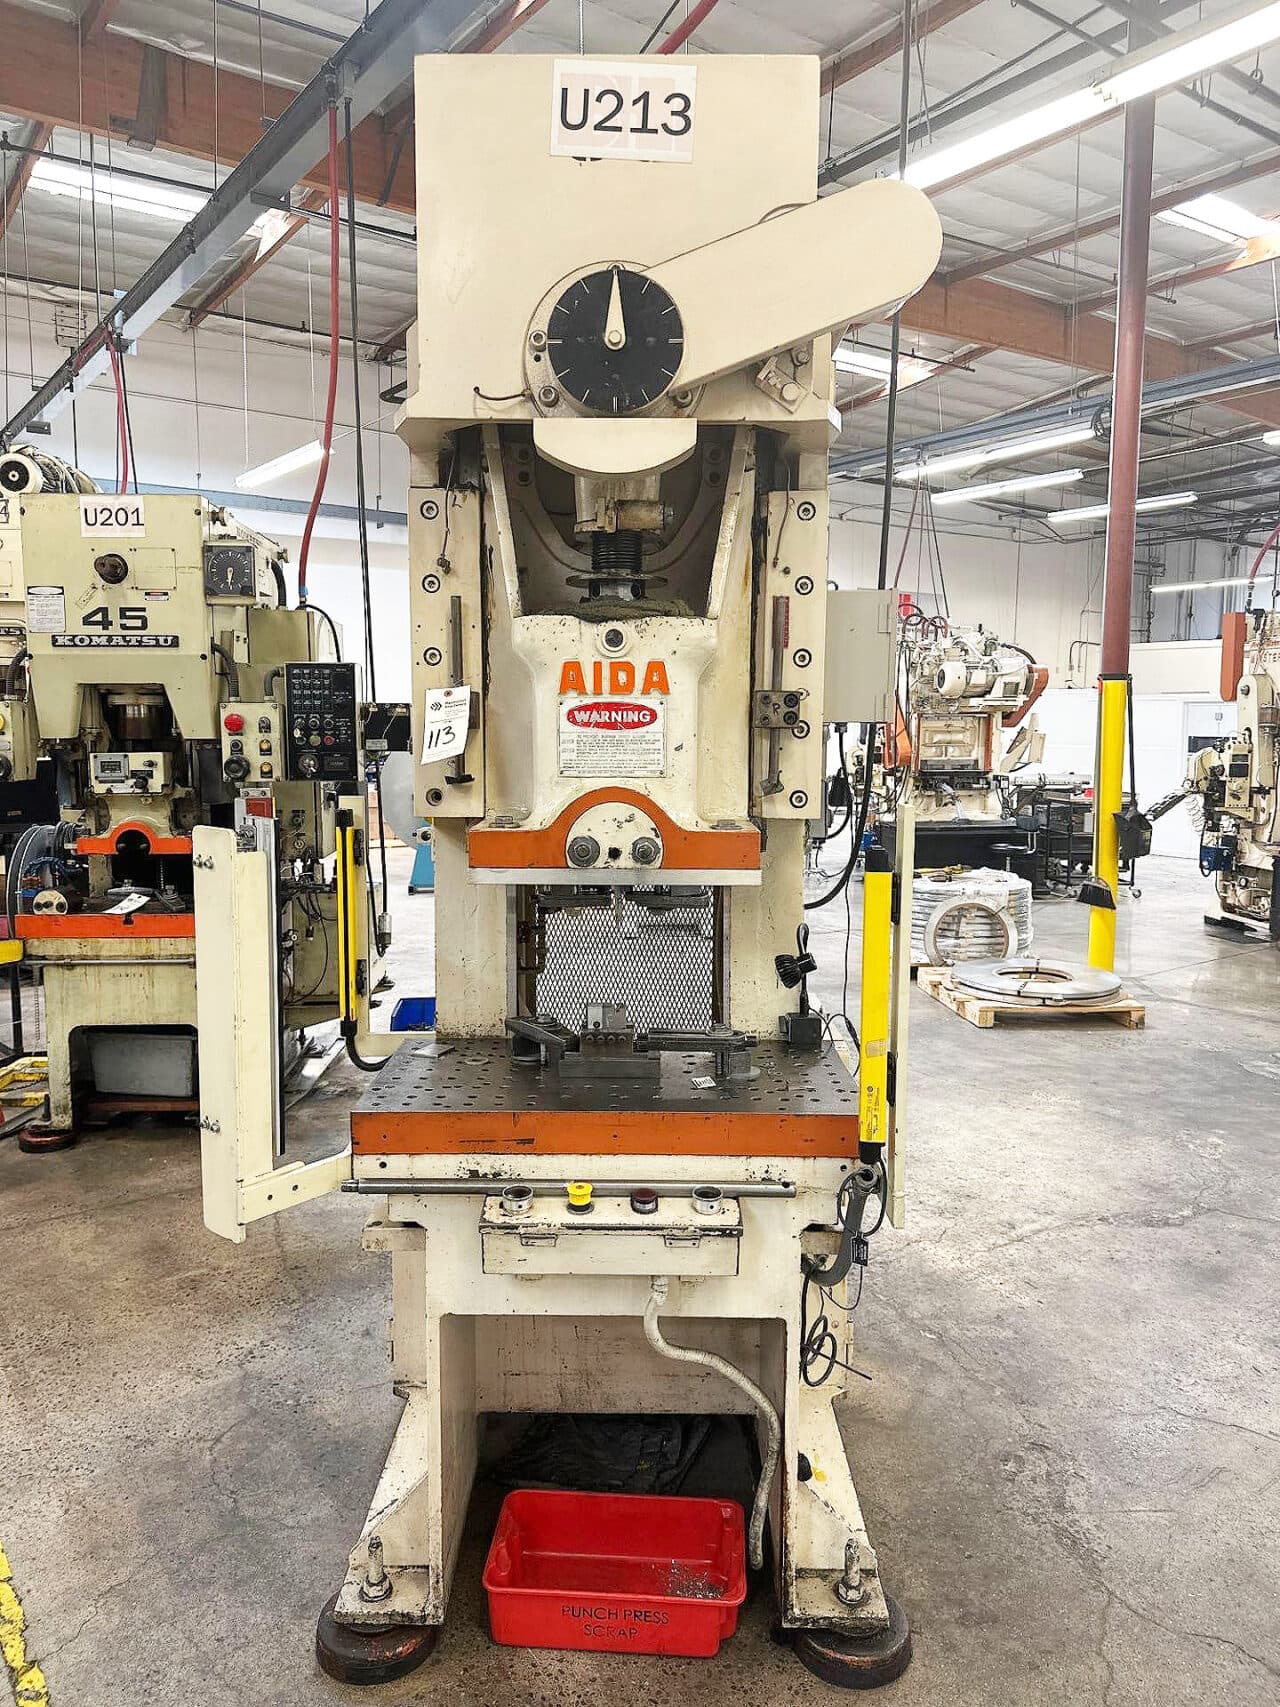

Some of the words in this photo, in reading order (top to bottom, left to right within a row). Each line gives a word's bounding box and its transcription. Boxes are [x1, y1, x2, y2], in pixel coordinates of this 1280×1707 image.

[560, 87, 692, 136] U213
[84, 507, 145, 526] U201
[82, 606, 148, 631] 45
[55, 636, 174, 646] KOMATSU
[559, 660, 671, 696] AIDA
[573, 709, 651, 723] WARNING
[428, 725, 456, 750] 113
[561, 1605, 619, 1620] PUNCH
[623, 1609, 670, 1625] PRESS
[583, 1624, 638, 1639] SCRAP
